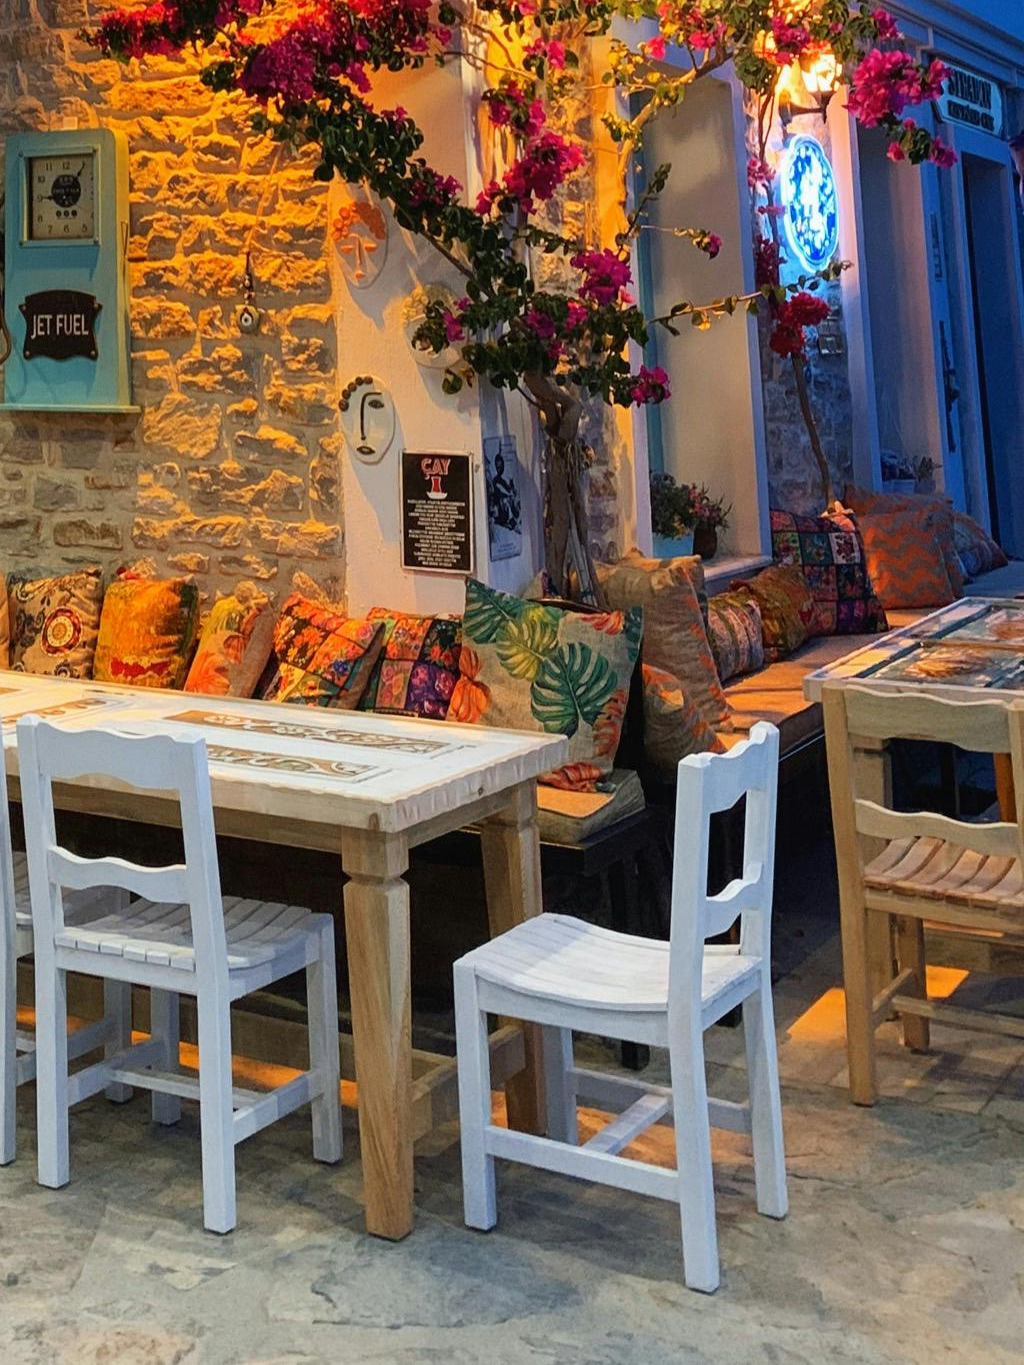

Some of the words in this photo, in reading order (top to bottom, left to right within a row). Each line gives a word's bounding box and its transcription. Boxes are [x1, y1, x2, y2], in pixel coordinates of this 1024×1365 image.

[30, 314, 53, 340] JET
[56, 313, 89, 336] FUEL
[420, 458, 451, 480] ÇAY
